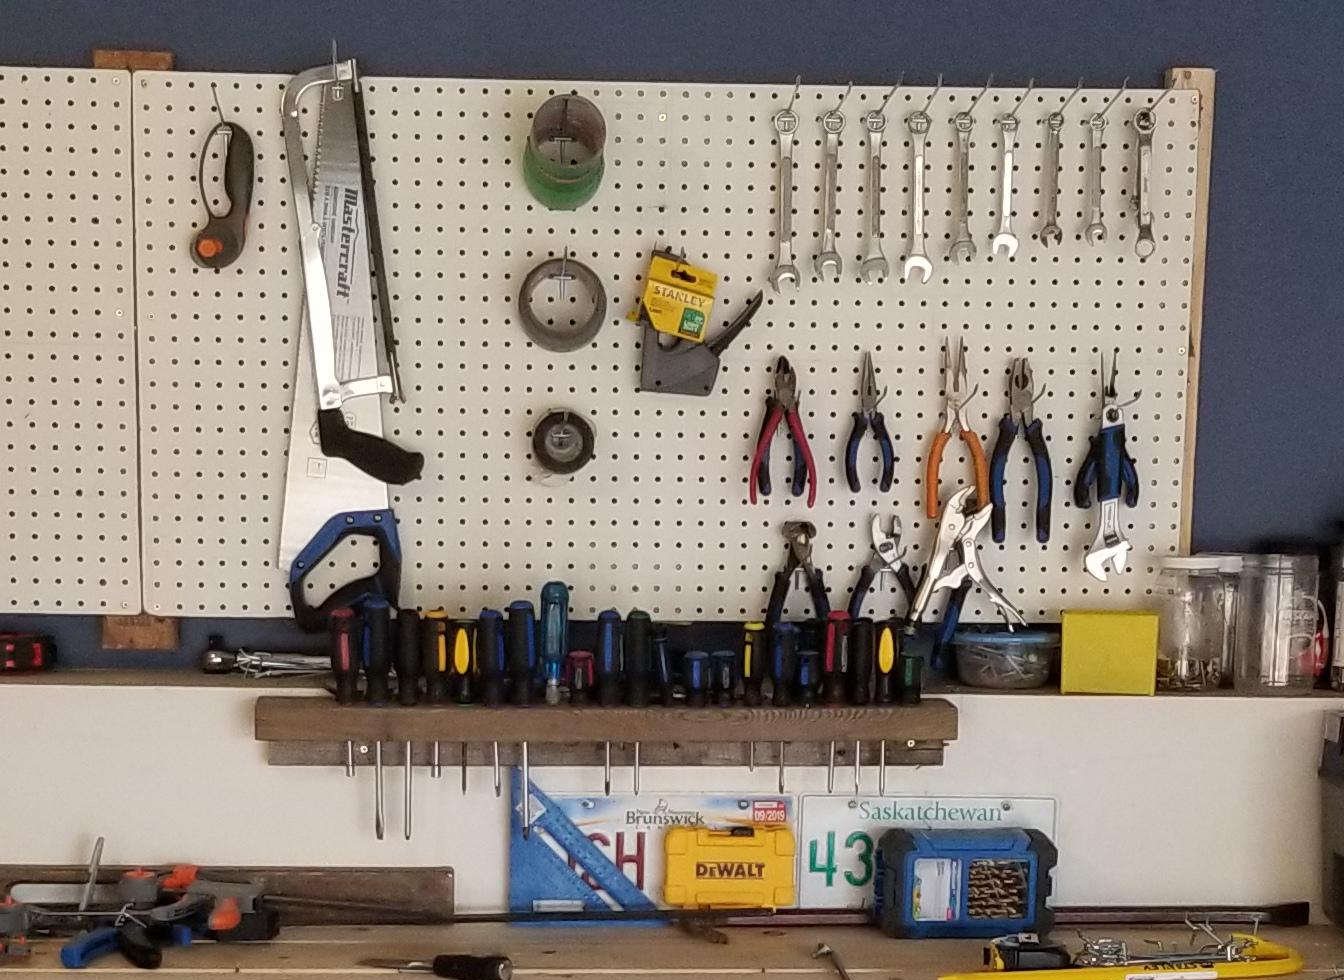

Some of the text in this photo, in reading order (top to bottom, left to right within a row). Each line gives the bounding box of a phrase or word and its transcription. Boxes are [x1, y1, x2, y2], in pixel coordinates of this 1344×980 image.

[336, 187, 359, 299] Mastercraft
[655, 285, 706, 308] STANLEY
[626, 810, 705, 825] Brunswick
[754, 810, 785, 821] 09/2019
[859, 801, 1002, 822] Saskatchewan
[808, 830, 874, 888] 43
